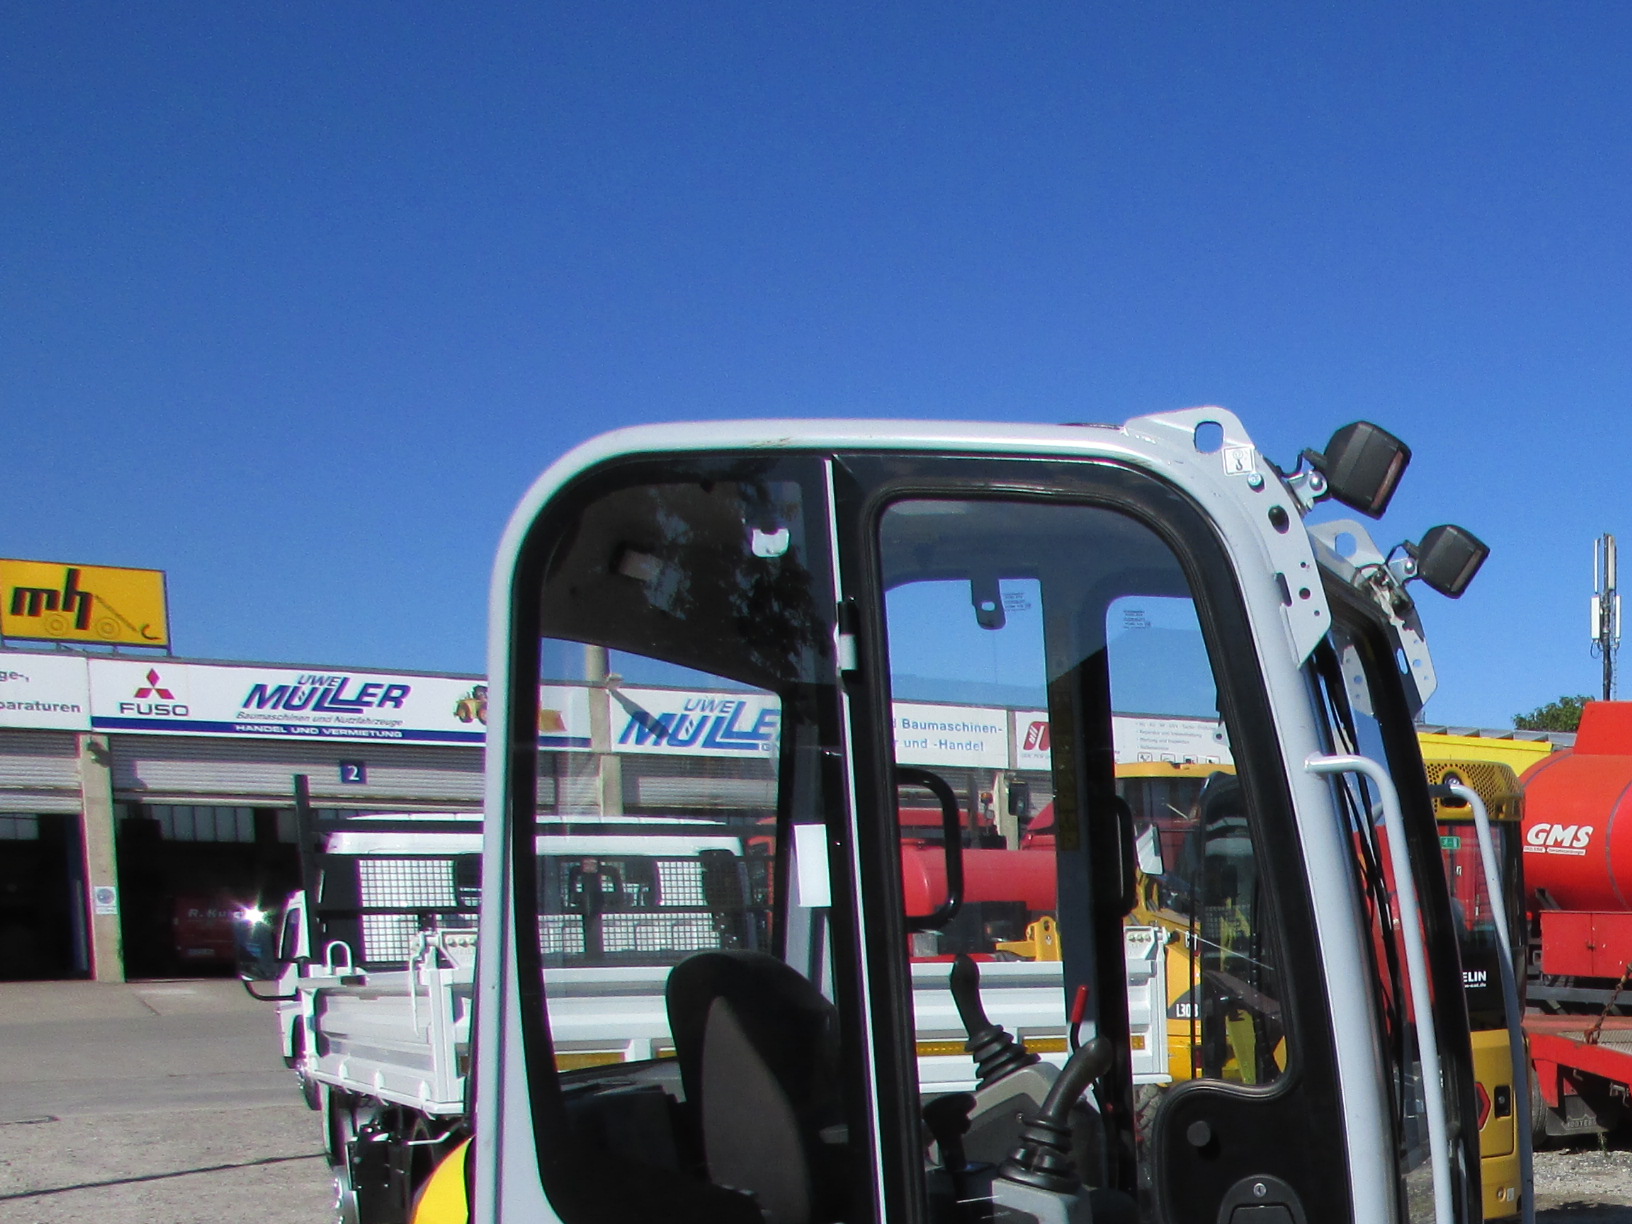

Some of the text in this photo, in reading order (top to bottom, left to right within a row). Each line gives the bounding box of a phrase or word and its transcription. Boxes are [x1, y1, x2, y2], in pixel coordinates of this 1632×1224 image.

[10, 568, 94, 631] mh
[297, 674, 341, 687] UWE
[242, 676, 411, 714] MÜLLER
[119, 702, 189, 717] FUSO
[683, 698, 735, 714] UWE
[236, 711, 310, 721] Baumaschinen
[312, 713, 332, 723] und
[235, 724, 403, 738] HANDEL UND VERMIETUNG
[618, 701, 781, 750] MÜLLE
[902, 718, 1003, 734] Baumaschinen-
[904, 738, 928, 749] und
[934, 739, 984, 752] -Handel
[347, 765, 360, 780] 2
[1527, 823, 1594, 848] GMS
